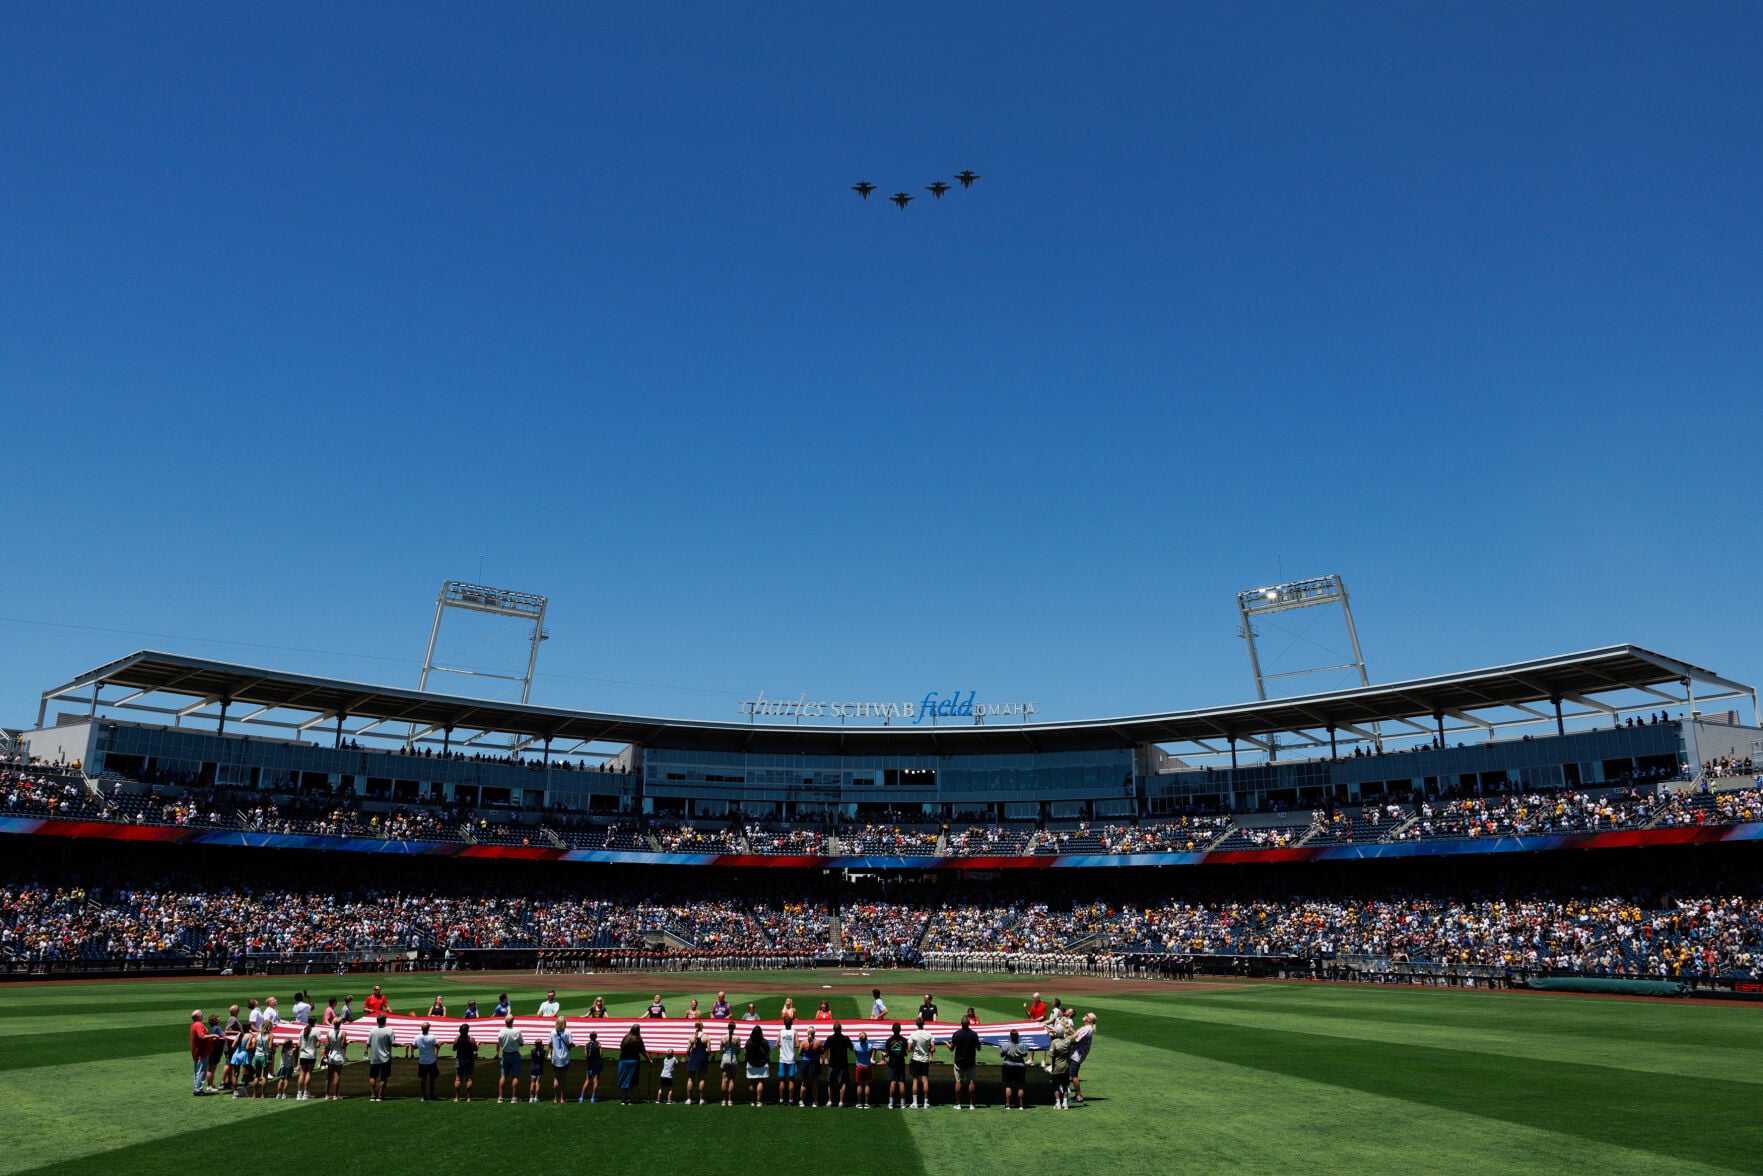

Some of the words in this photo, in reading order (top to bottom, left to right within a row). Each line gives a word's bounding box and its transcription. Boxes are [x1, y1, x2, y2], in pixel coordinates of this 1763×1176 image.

[741, 690, 826, 717] charles
[831, 701, 915, 718] SCHWAB
[912, 690, 976, 725] field
[976, 702, 1036, 716] OMAHA
[1734, 983, 1763, 993] ESP
